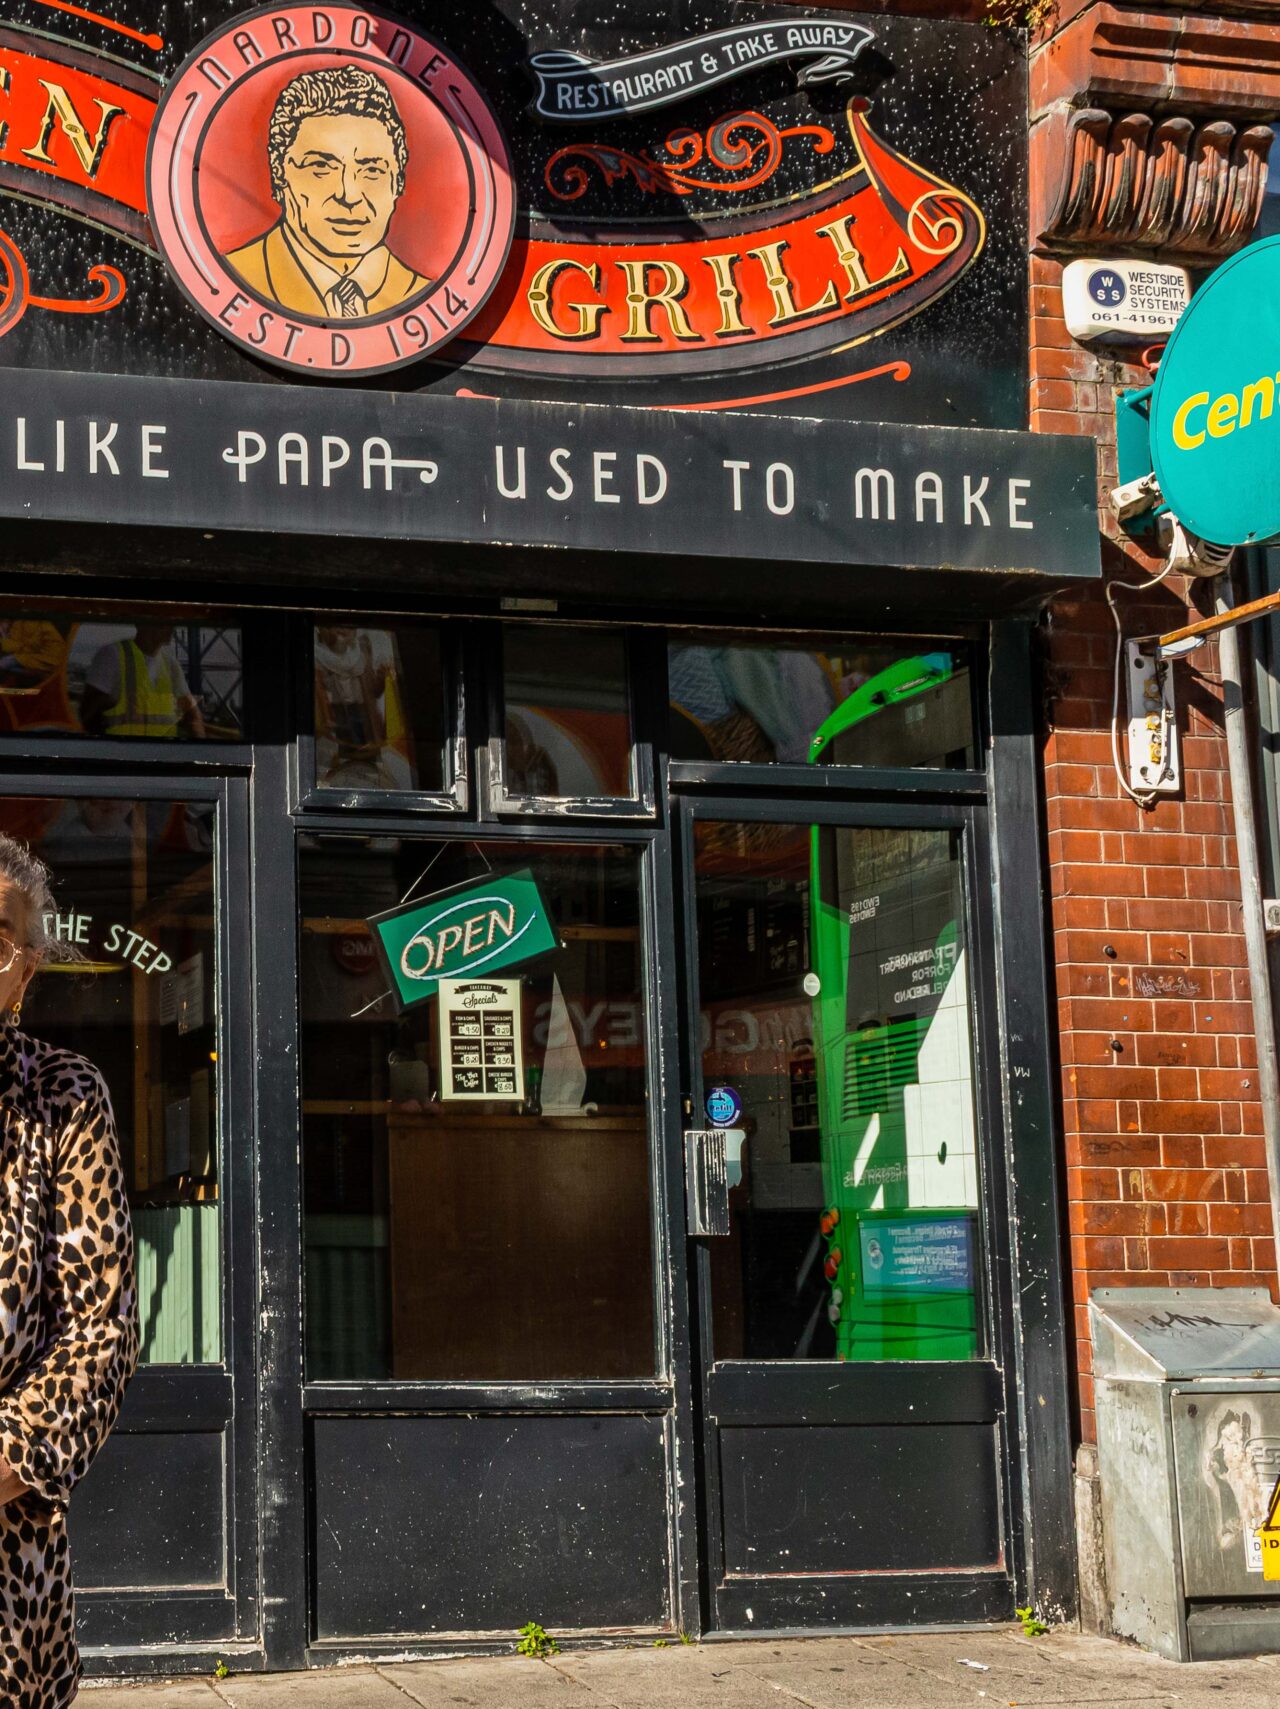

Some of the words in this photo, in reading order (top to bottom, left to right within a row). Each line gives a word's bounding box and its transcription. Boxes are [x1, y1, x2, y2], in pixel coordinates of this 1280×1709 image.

[196, 11, 448, 92] NARDONE
[556, 61, 694, 109] RESTAURANT
[700, 53, 718, 74] &
[721, 33, 778, 65] TAKE
[787, 27, 855, 48] AWAY
[527, 214, 913, 345] GRILL
[1128, 271, 1185, 287] WESTSIDE
[1129, 284, 1185, 299] SECURITY
[1130, 297, 1187, 312] SYSTEMS
[387, 287, 471, 358] 1914
[1172, 370, 1280, 450] Cen
[16, 418, 170, 479] LIKE
[222, 429, 438, 491] PAPA
[495, 445, 668, 505] USED
[722, 460, 794, 516] TO
[854, 468, 1034, 530] MAKE
[42, 913, 92, 944] THE
[104, 924, 172, 975] STEP
[400, 903, 515, 979] OPEN
[462, 992, 498, 1009] Specials
